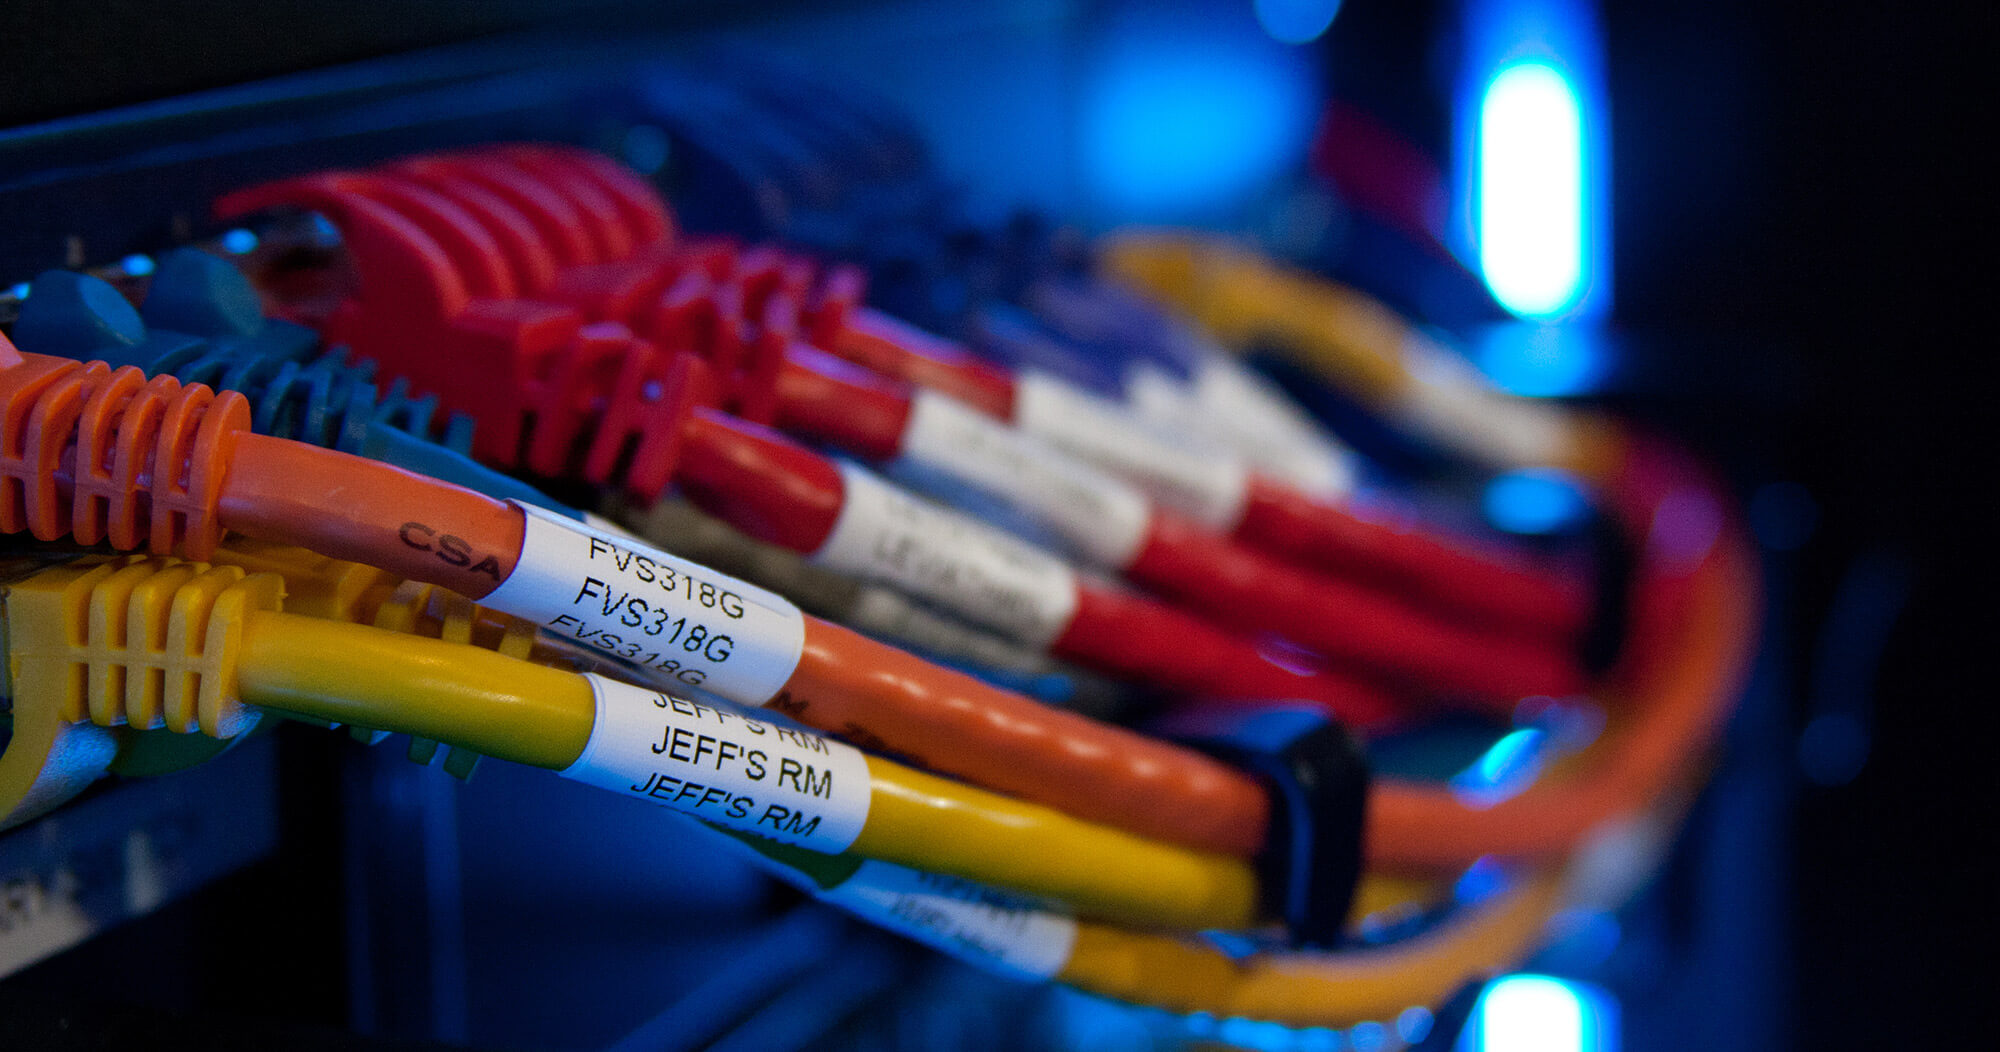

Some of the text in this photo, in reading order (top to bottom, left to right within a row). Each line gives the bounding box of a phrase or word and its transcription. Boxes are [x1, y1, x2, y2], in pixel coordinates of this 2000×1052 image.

[399, 521, 501, 582] CSA
[589, 537, 745, 619] FVS318G
[549, 613, 708, 686] FVS318G
[573, 576, 735, 663] FVS318G
[651, 725, 832, 800] JEFF'S RM
[773, 724, 830, 756] RM
[630, 772, 755, 819] JEFF'S
[757, 803, 822, 838] RM
